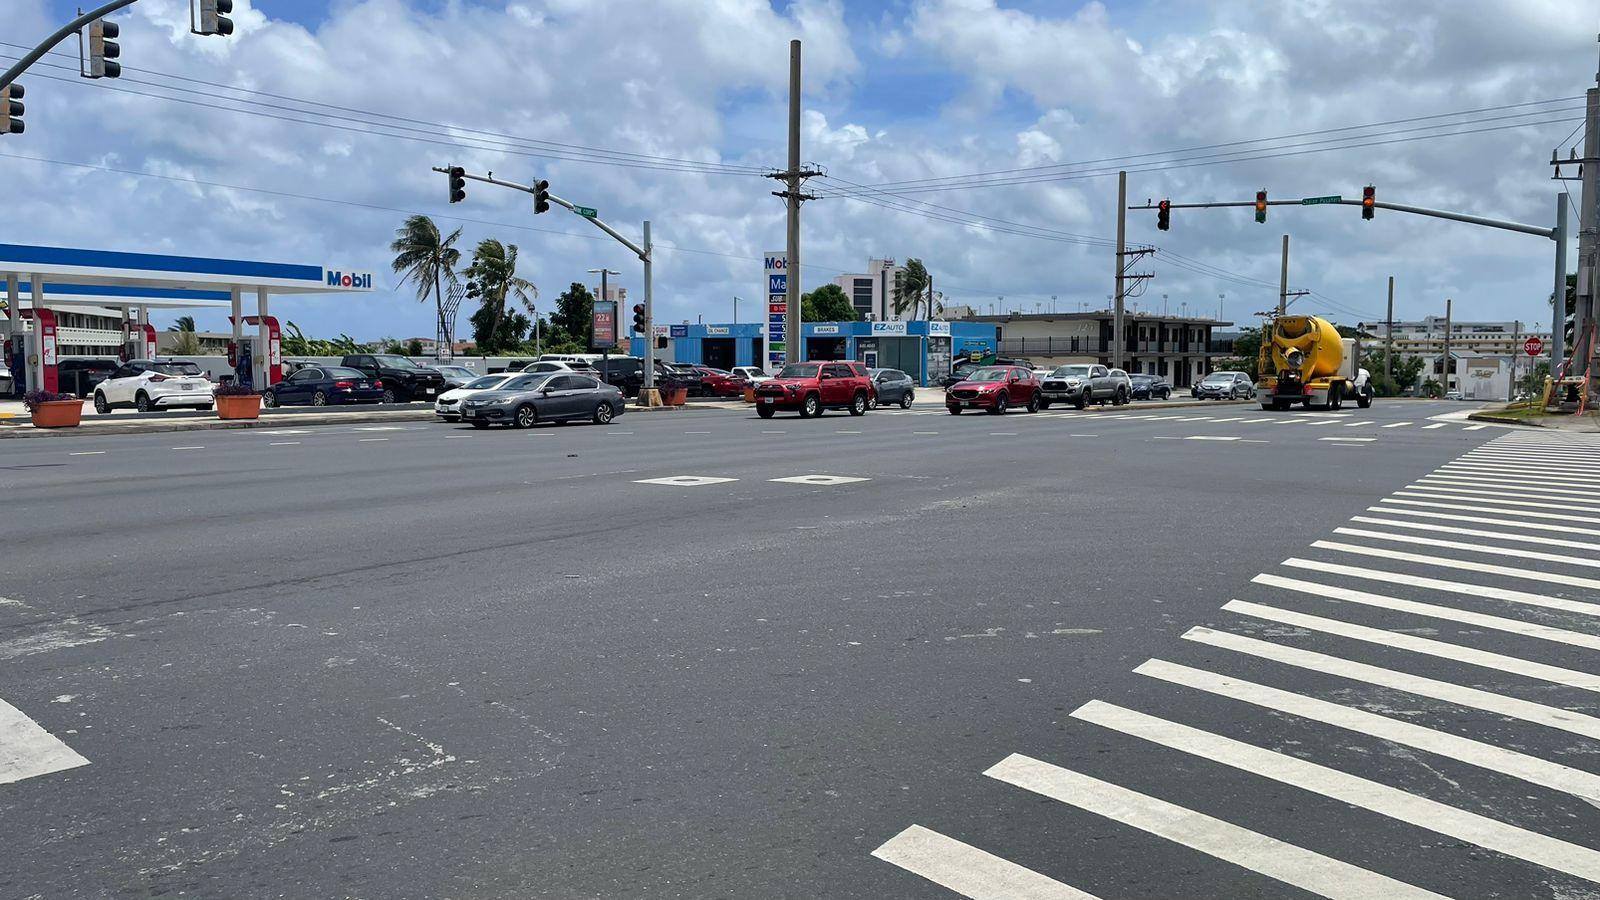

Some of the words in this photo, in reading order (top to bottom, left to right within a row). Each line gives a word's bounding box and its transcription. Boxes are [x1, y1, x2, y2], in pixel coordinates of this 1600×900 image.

[765, 257, 787, 269] Mob
[327, 271, 371, 288] Mobil
[1525, 342, 1541, 351] STOP
